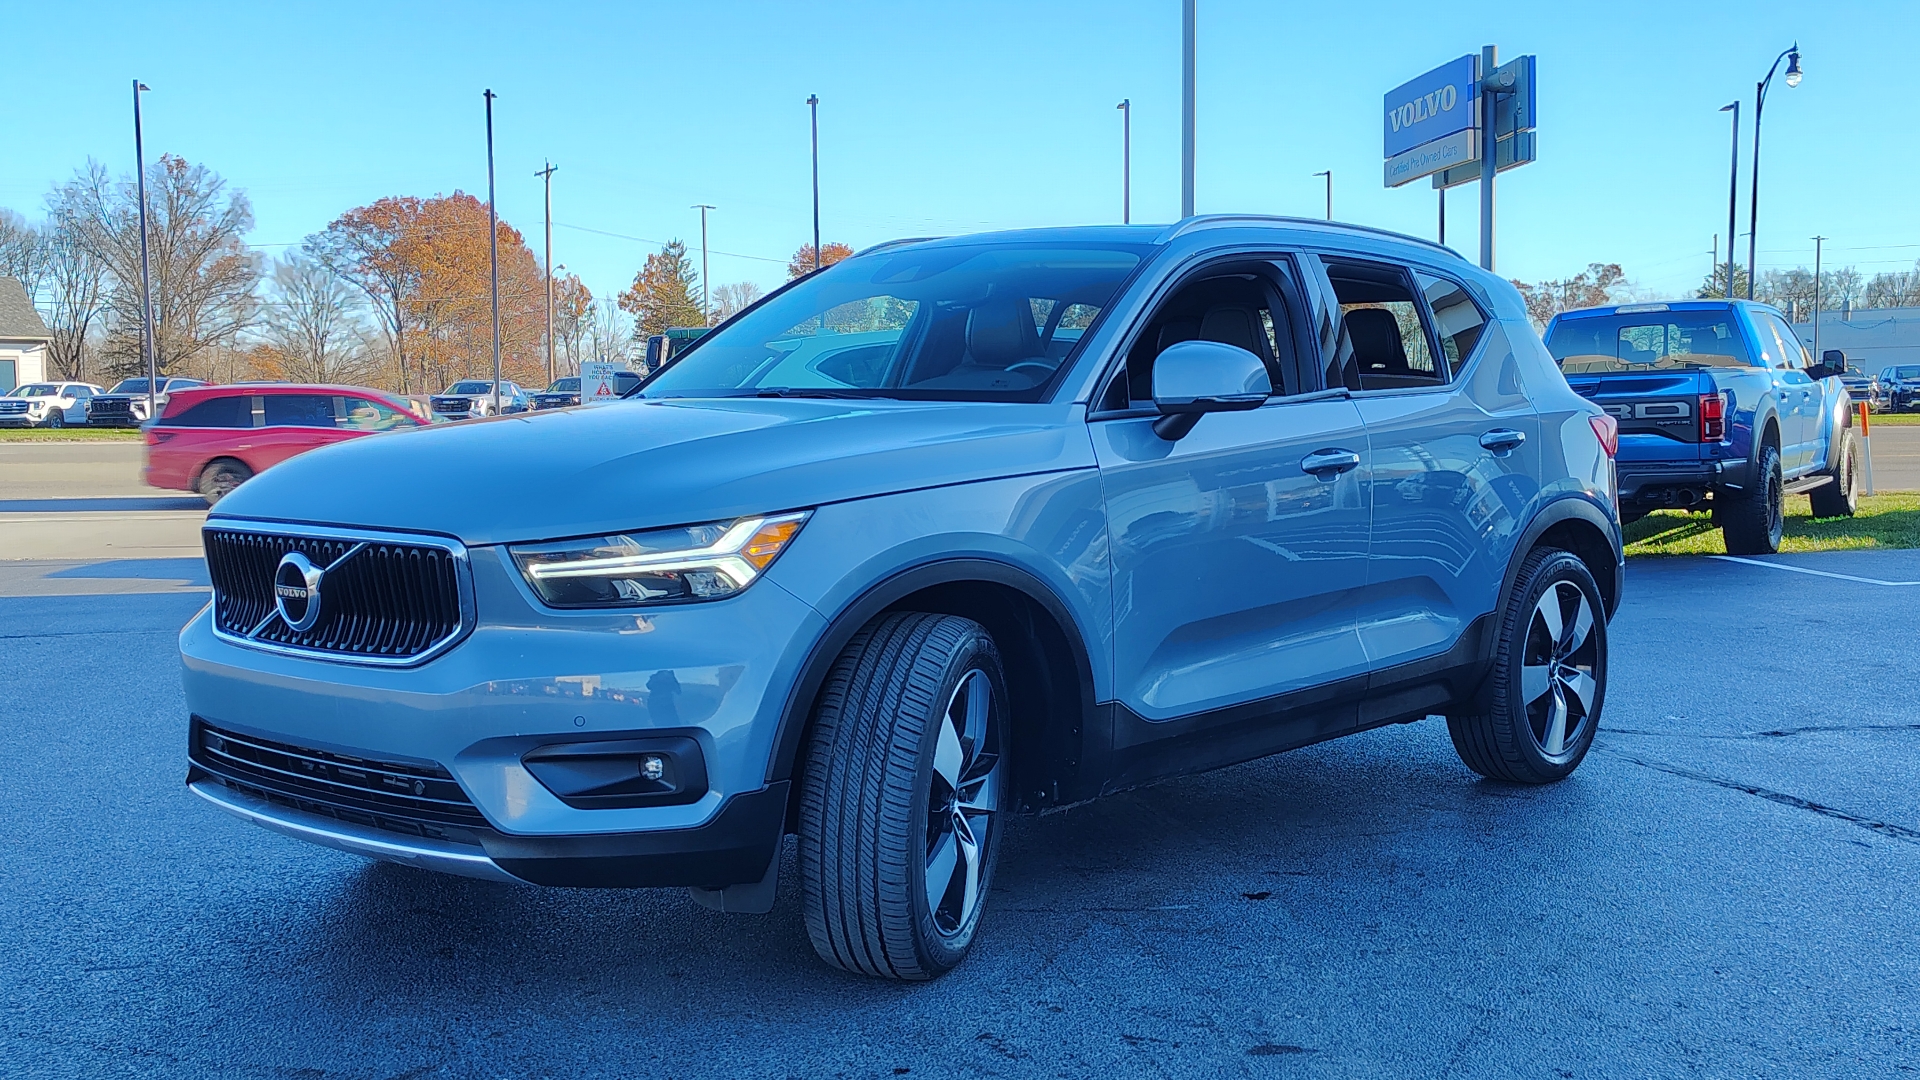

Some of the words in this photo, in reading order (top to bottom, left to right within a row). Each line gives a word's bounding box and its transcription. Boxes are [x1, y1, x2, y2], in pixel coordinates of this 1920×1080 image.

[1389, 84, 1457, 133] VOLVO
[1390, 160, 1410, 177] Certified
[1442, 145, 1458, 158] Cars
[1601, 402, 1691, 420] RD
[277, 587, 308, 598] VOLVO
